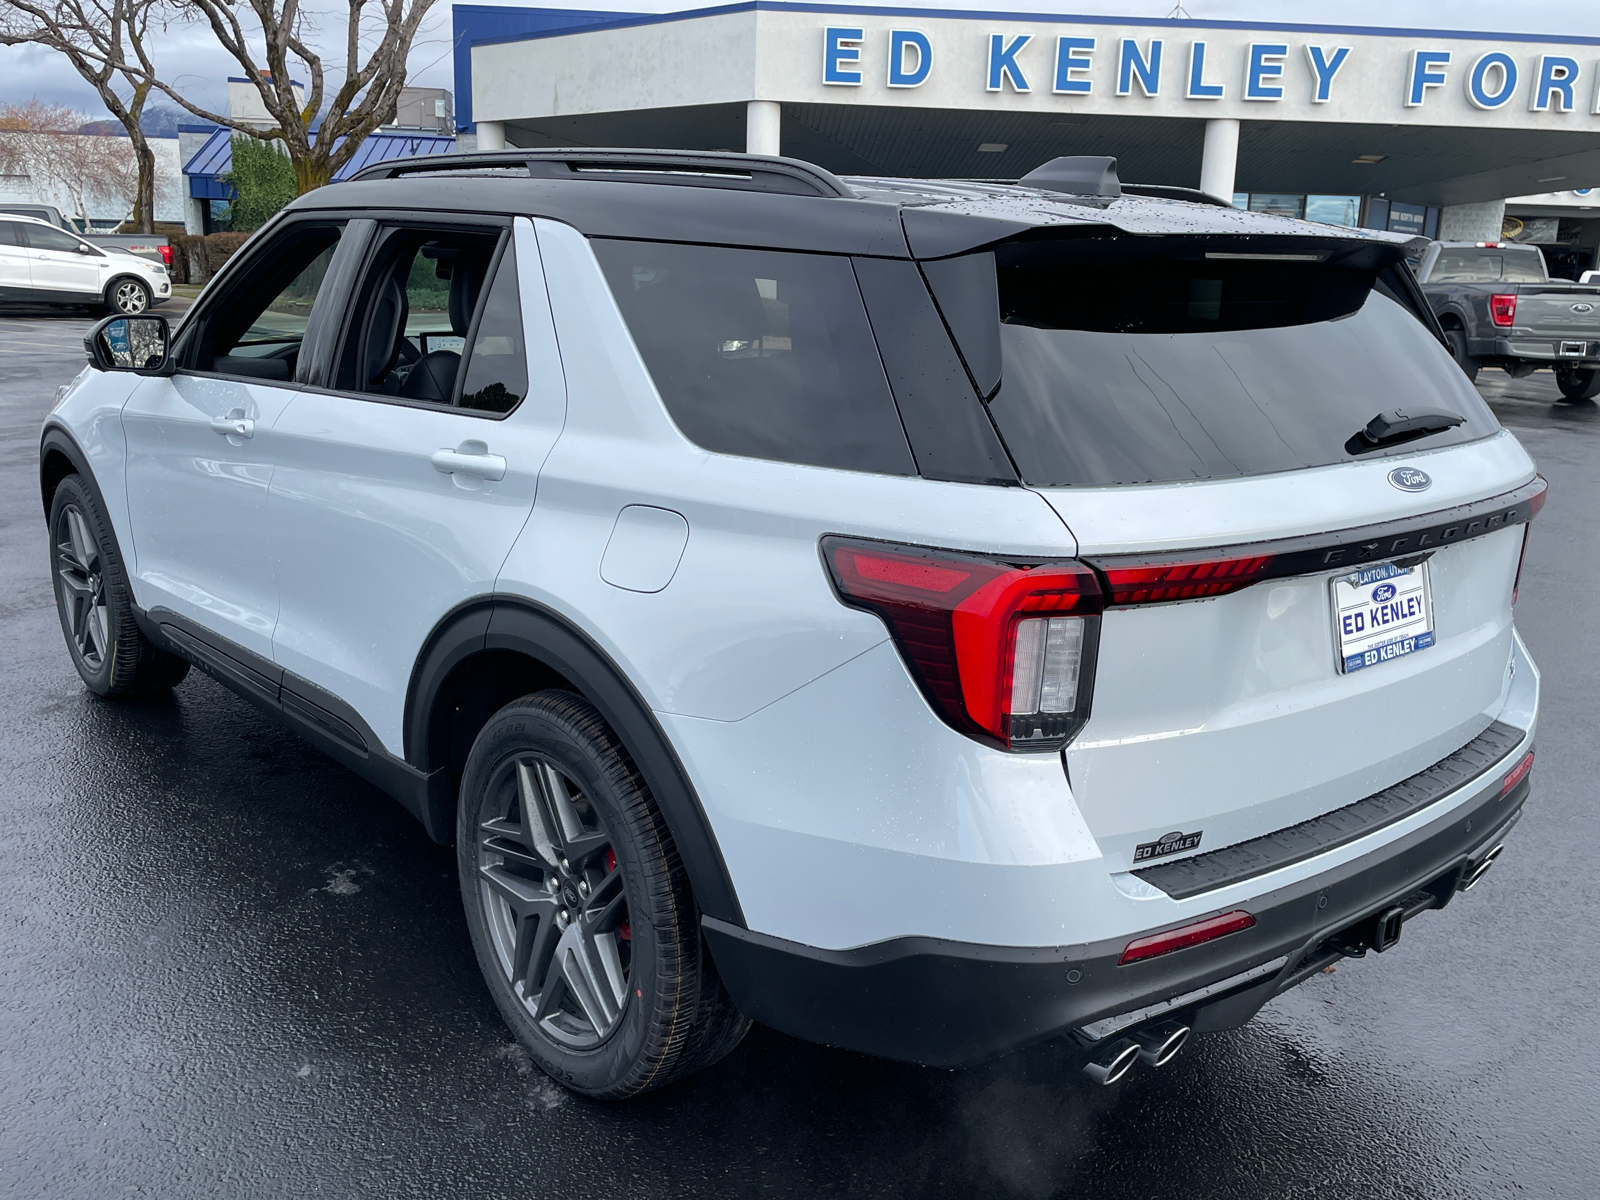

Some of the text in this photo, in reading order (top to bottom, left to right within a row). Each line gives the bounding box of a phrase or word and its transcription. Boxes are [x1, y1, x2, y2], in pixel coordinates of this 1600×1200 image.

[822, 26, 1600, 115] ED KENLEY FOR
[1321, 510, 1517, 564] EXPLORER
[1343, 594, 1422, 635] ED KENLEY
[1364, 650, 1378, 666] ED
[1380, 638, 1416, 661] KENLEY
[1135, 835, 1201, 859] ED KENLEY
